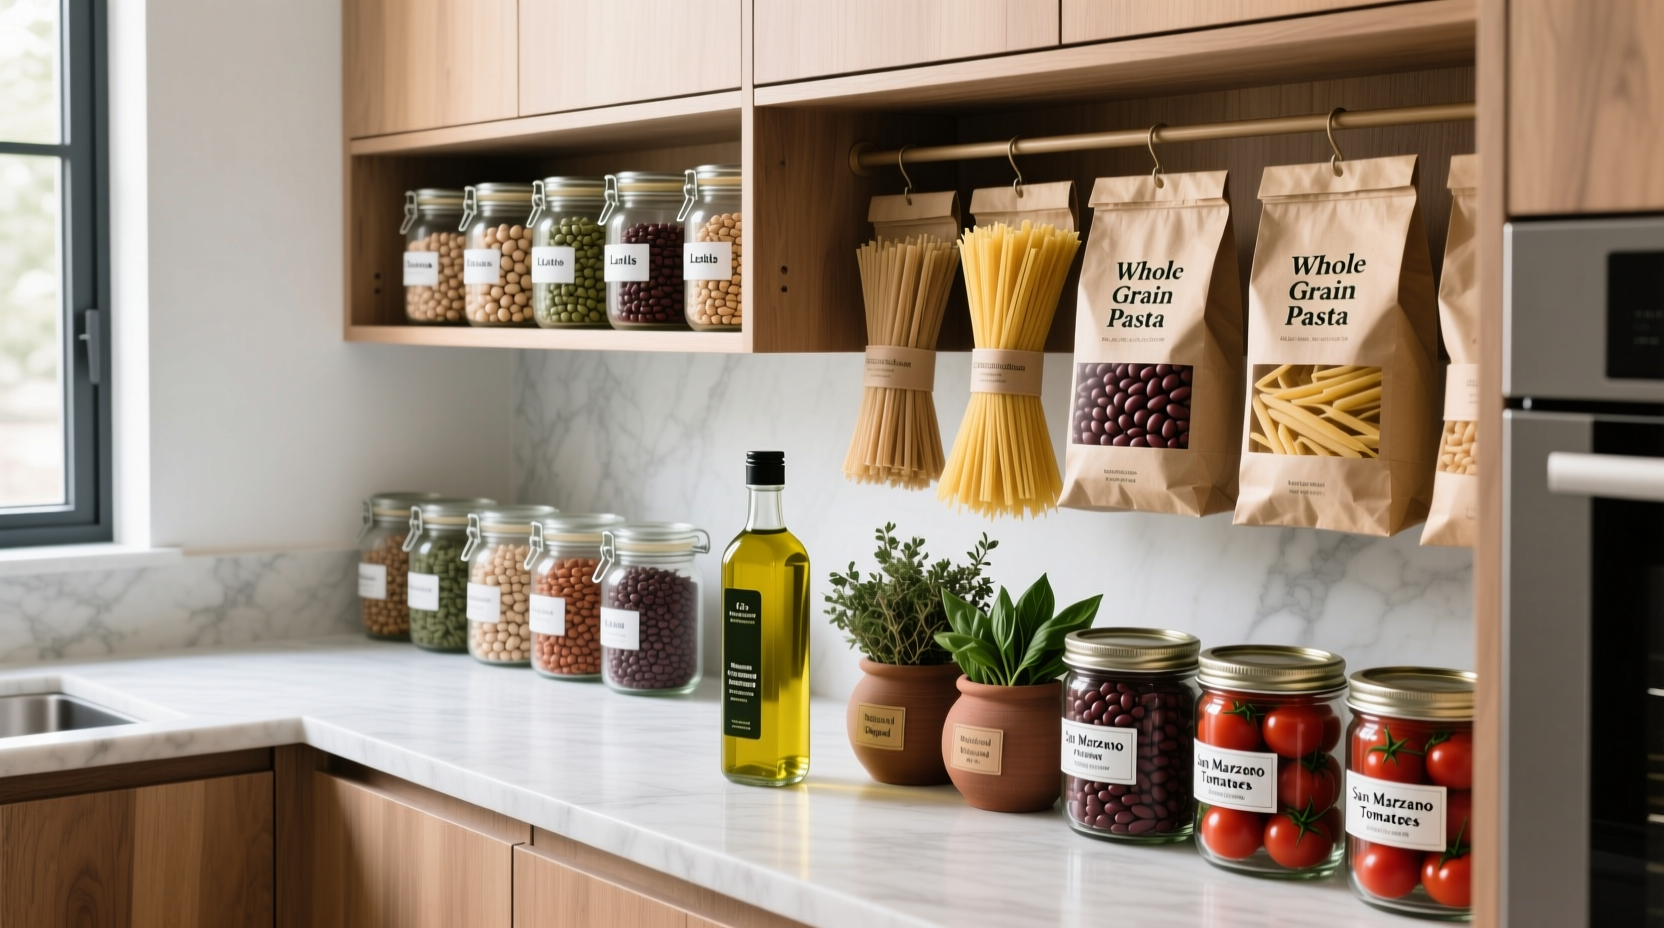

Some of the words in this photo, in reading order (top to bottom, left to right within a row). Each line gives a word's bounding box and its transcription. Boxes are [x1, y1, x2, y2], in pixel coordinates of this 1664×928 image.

[1117, 260, 1184, 281] Whole
[1292, 253, 1366, 275] Whole
[1112, 285, 1173, 304] Grain
[1289, 280, 1356, 301] Grain
[1106, 308, 1165, 328] Pasta
[1285, 305, 1348, 326] Pasta
[1352, 786, 1370, 803] San
[1373, 791, 1434, 812] Marzano
